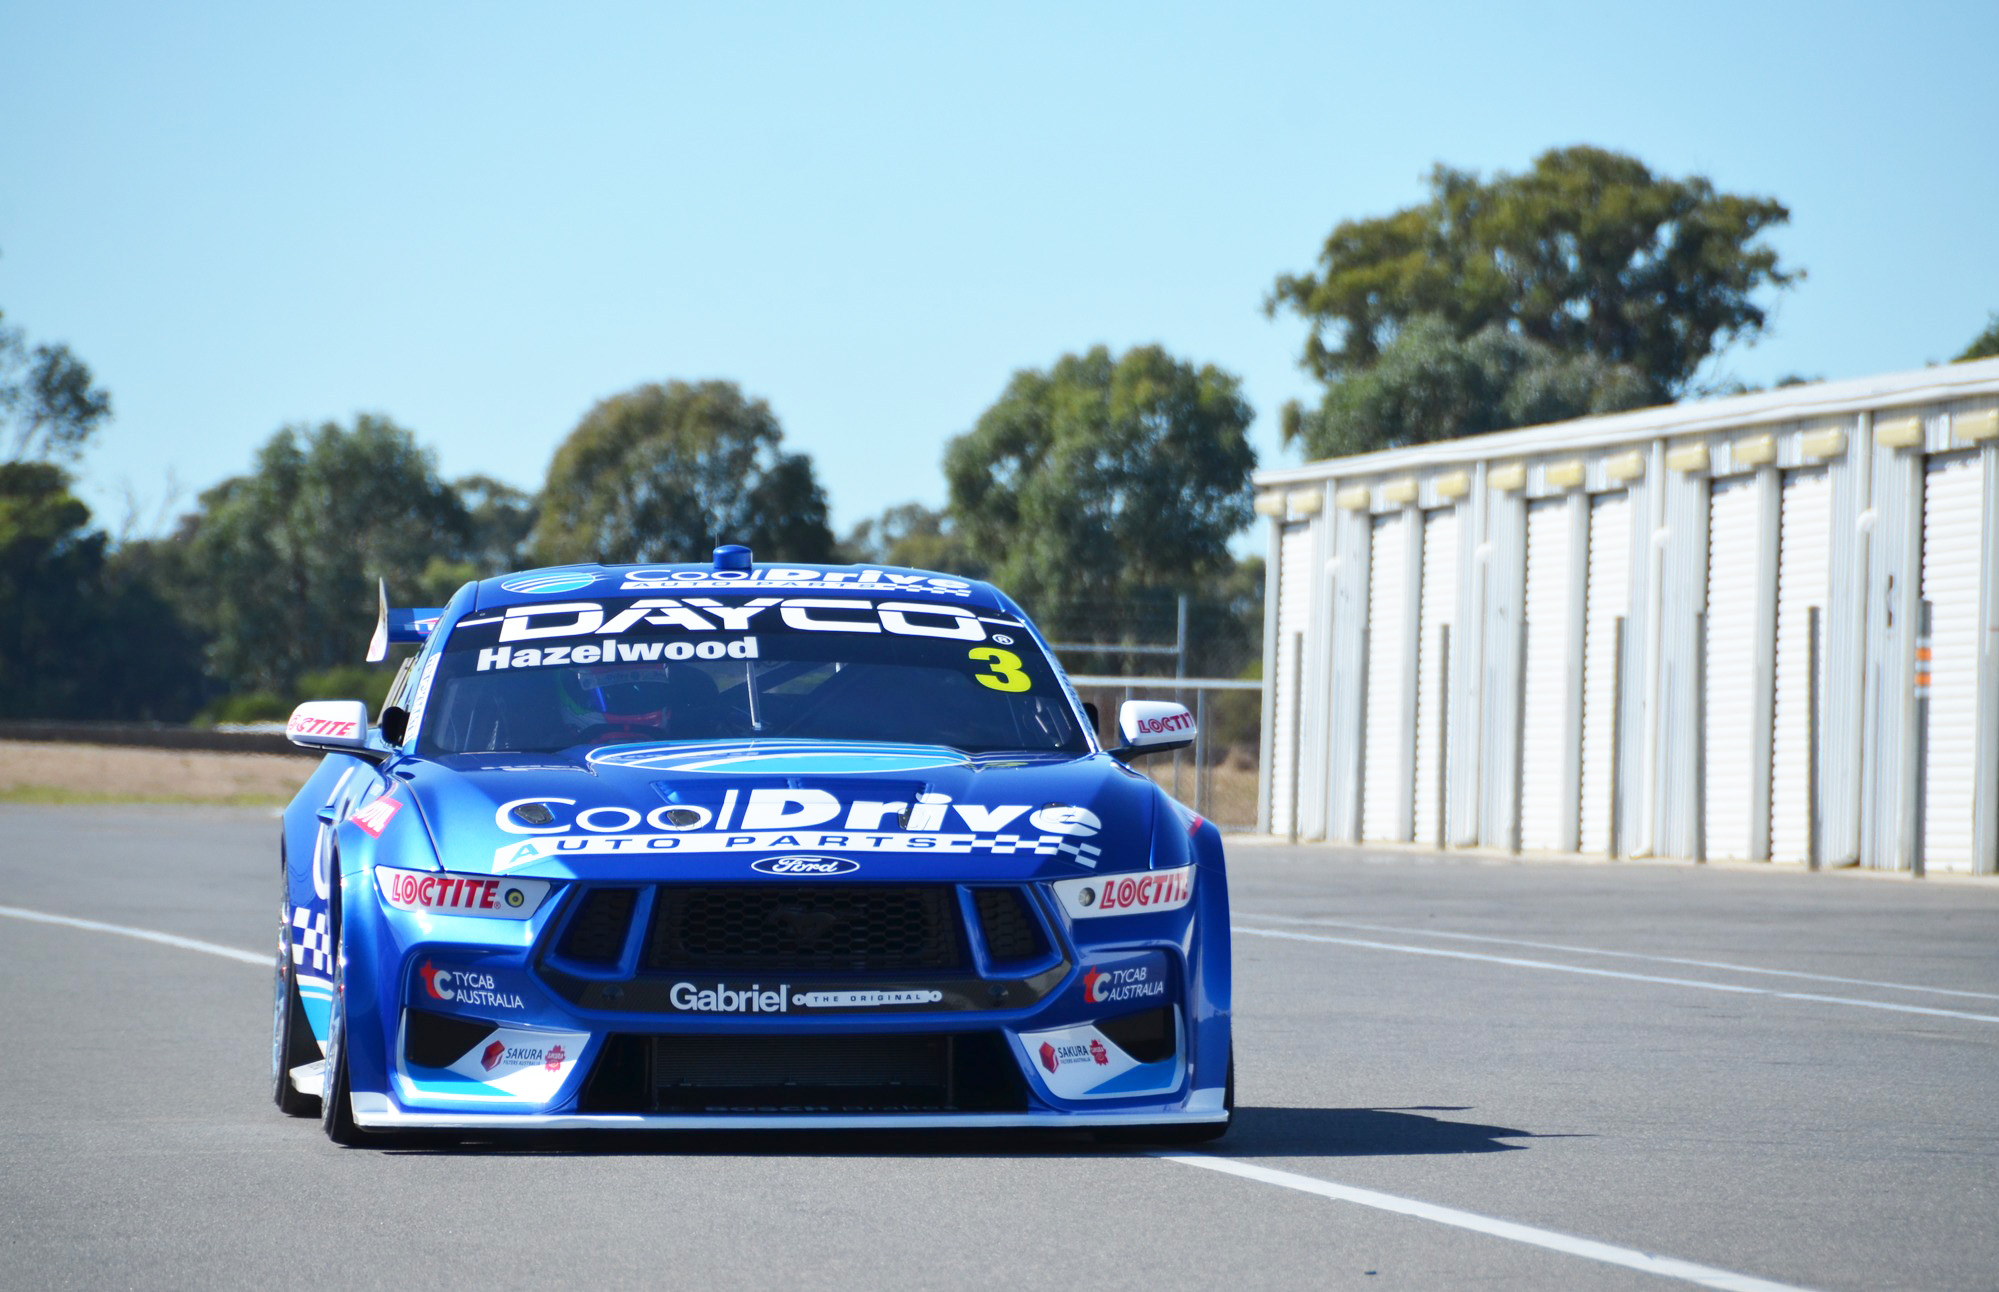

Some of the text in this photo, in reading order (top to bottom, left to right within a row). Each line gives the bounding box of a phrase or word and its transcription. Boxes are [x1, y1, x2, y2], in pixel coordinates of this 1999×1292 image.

[624, 568, 971, 589] CoolDrive
[498, 597, 988, 642] DAYCO
[476, 636, 759, 672] Hazelwood
[968, 647, 1032, 693] 3
[1137, 711, 1195, 734] LOCTIT
[494, 789, 1102, 837] CoolDrive
[510, 836, 938, 863] AUTO PARTS
[772, 857, 839, 873] Ford
[391, 873, 500, 909] LOCTITE
[452, 971, 495, 990] TYCAB
[1113, 967, 1147, 985] TYCAB
[456, 989, 525, 1010] AUSTRALIA
[669, 982, 788, 1013] Gabriel
[813, 993, 922, 1003] THE ORIGINAL
[1108, 980, 1164, 1002] AUSTRALIA
[505, 1047, 543, 1061] SAKURA
[1057, 1044, 1090, 1059] SAKURA
